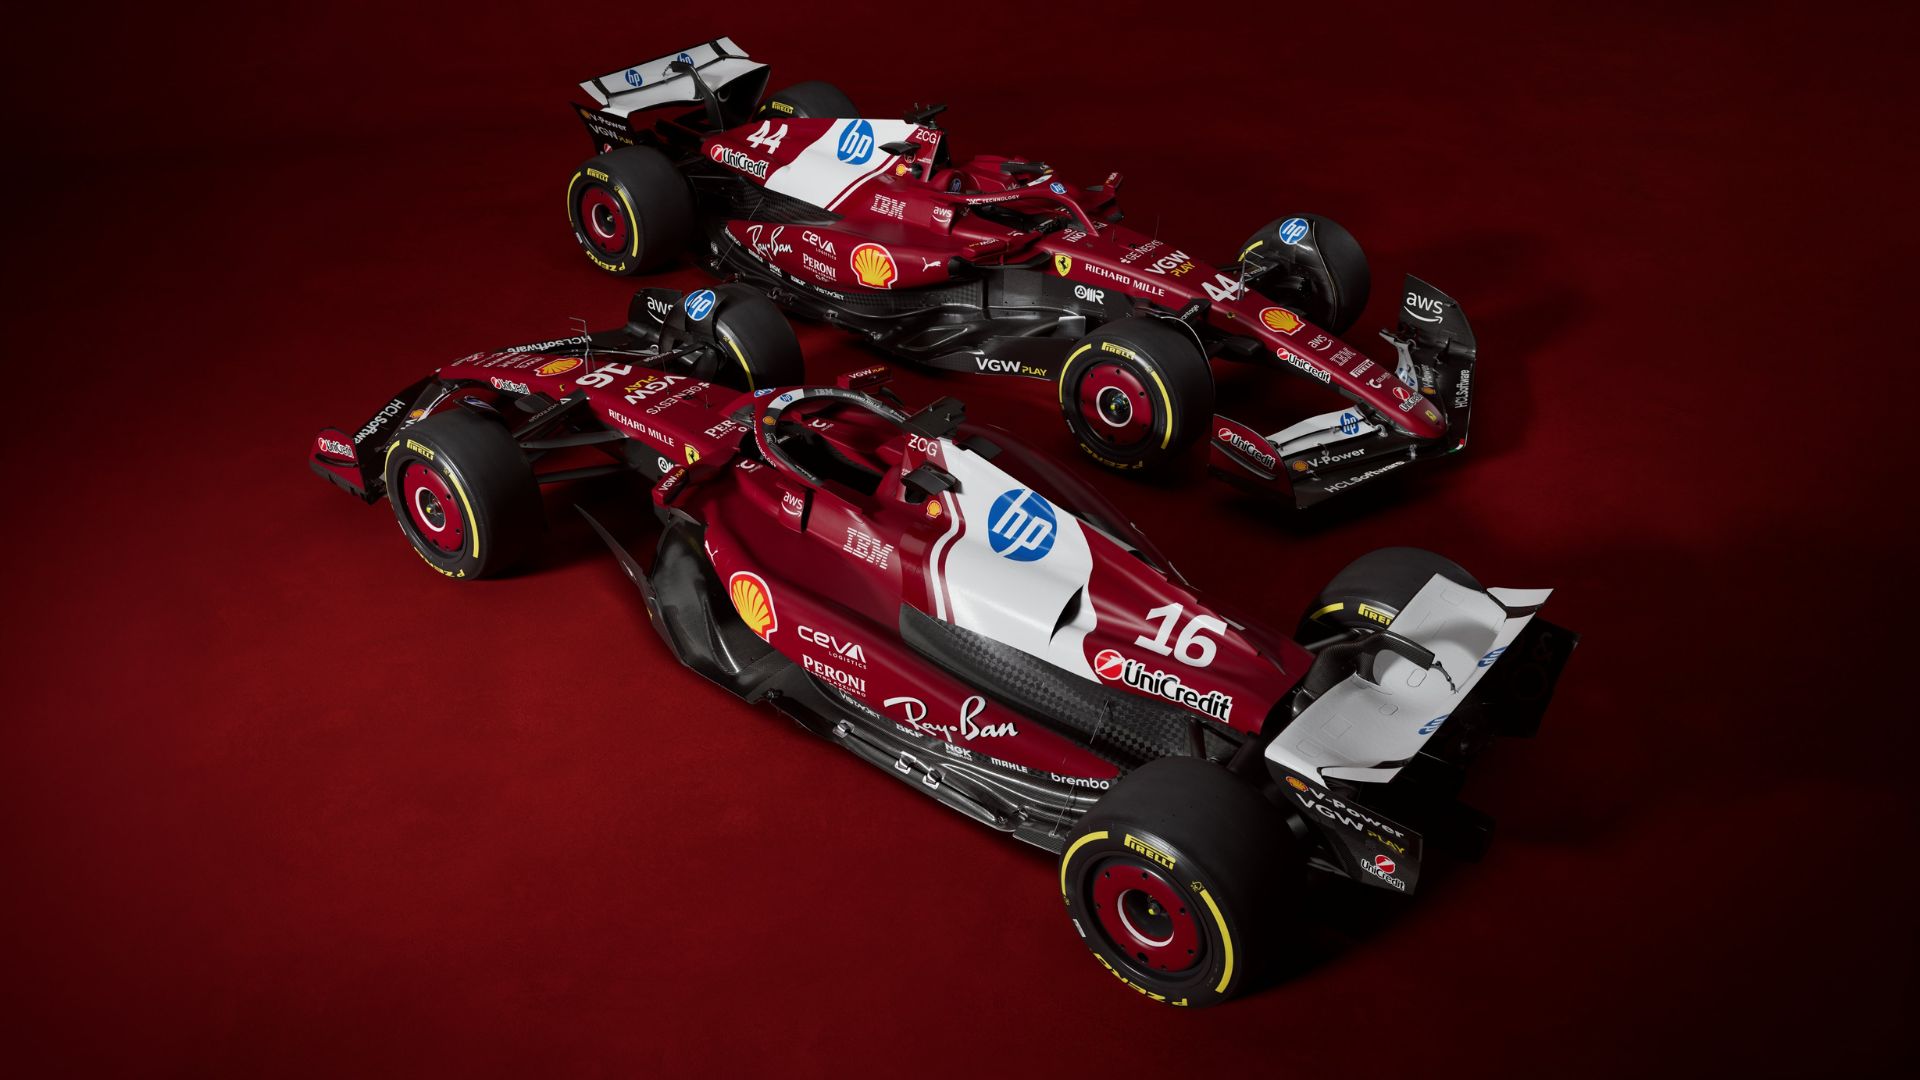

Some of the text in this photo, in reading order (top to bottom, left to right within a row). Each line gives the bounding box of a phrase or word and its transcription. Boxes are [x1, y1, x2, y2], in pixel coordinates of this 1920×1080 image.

[627, 69, 642, 87] hp
[772, 101, 794, 114] PIRELLI
[588, 122, 619, 141] VGW
[747, 120, 788, 154] 44
[837, 119, 873, 163] hp
[915, 128, 937, 144] ZCG
[587, 168, 609, 183] PIRELLI
[722, 149, 769, 179] UniCredit
[869, 193, 906, 220] IBM
[983, 194, 1020, 204] TECHNOLOGY
[933, 206, 953, 218] aws
[1281, 218, 1309, 244] hp
[802, 253, 836, 278] PERONI
[1145, 250, 1190, 275] VGW
[1170, 261, 1196, 277] PLAY
[1085, 263, 1165, 297] RICHARD MILLE
[1201, 273, 1249, 302] 44
[686, 289, 716, 321] hp
[1406, 292, 1443, 314] aws
[1101, 342, 1137, 360] PIRELLI
[1308, 334, 1327, 348] aws
[576, 362, 632, 388] 16
[849, 368, 872, 379] VGW
[975, 356, 1047, 377] VGW PLAY
[1287, 353, 1331, 384] UniCredit
[1349, 358, 1375, 378] PIRELLI
[624, 375, 659, 393] PLAY
[624, 375, 687, 405] VGW
[608, 408, 675, 447] RICHARD MILLE
[704, 418, 737, 438] PER
[1340, 412, 1359, 435] hp
[406, 439, 435, 461] PIRELLI
[907, 433, 938, 457] ZCG
[1229, 434, 1276, 470] UniCredit
[1308, 447, 1365, 468] V-Power
[1324, 460, 1405, 494] HCLSoftware
[783, 491, 803, 509] aws
[990, 489, 1054, 558] hp
[843, 527, 894, 570] IBM
[1134, 602, 1228, 668] 16
[828, 651, 867, 670] LOGISTICS
[802, 654, 866, 693] PERONI
[1122, 659, 1231, 722] UniCredit
[991, 757, 1029, 774] MAHLE
[1051, 772, 1110, 790] brembo
[1296, 792, 1364, 832] VGW
[1309, 787, 1404, 838] V-Power
[1124, 833, 1176, 870] PIRELLI
[1360, 858, 1406, 891] UniCredit
